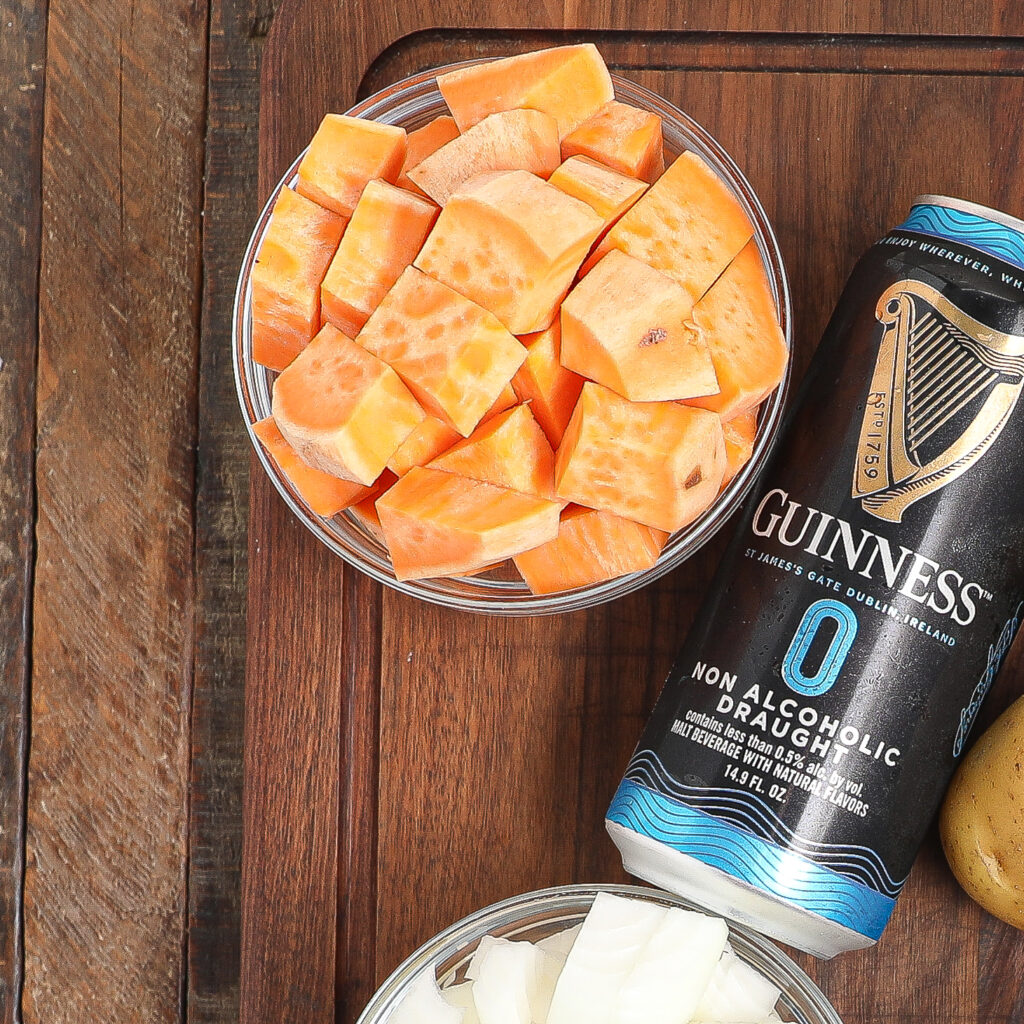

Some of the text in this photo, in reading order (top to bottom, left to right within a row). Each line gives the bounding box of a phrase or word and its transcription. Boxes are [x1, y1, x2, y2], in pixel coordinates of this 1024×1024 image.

[919, 242, 993, 277] WHEREVER,
[864, 432, 883, 480] 1759
[744, 548, 956, 647] ST JAMES'S GATE DUBLIN, IRELAND
[781, 598, 859, 697] 0
[685, 709, 864, 798] contains less than 0.5% alc. by vol.
[691, 661, 738, 693] NON
[743, 683, 901, 767] ALCOHOLIC
[716, 694, 849, 765] DRAUGHT
[670, 719, 869, 818] MALT BEVERAGE WITH NATURAL FLAVORS
[724, 764, 787, 804] 14.9 FL. OZ.
